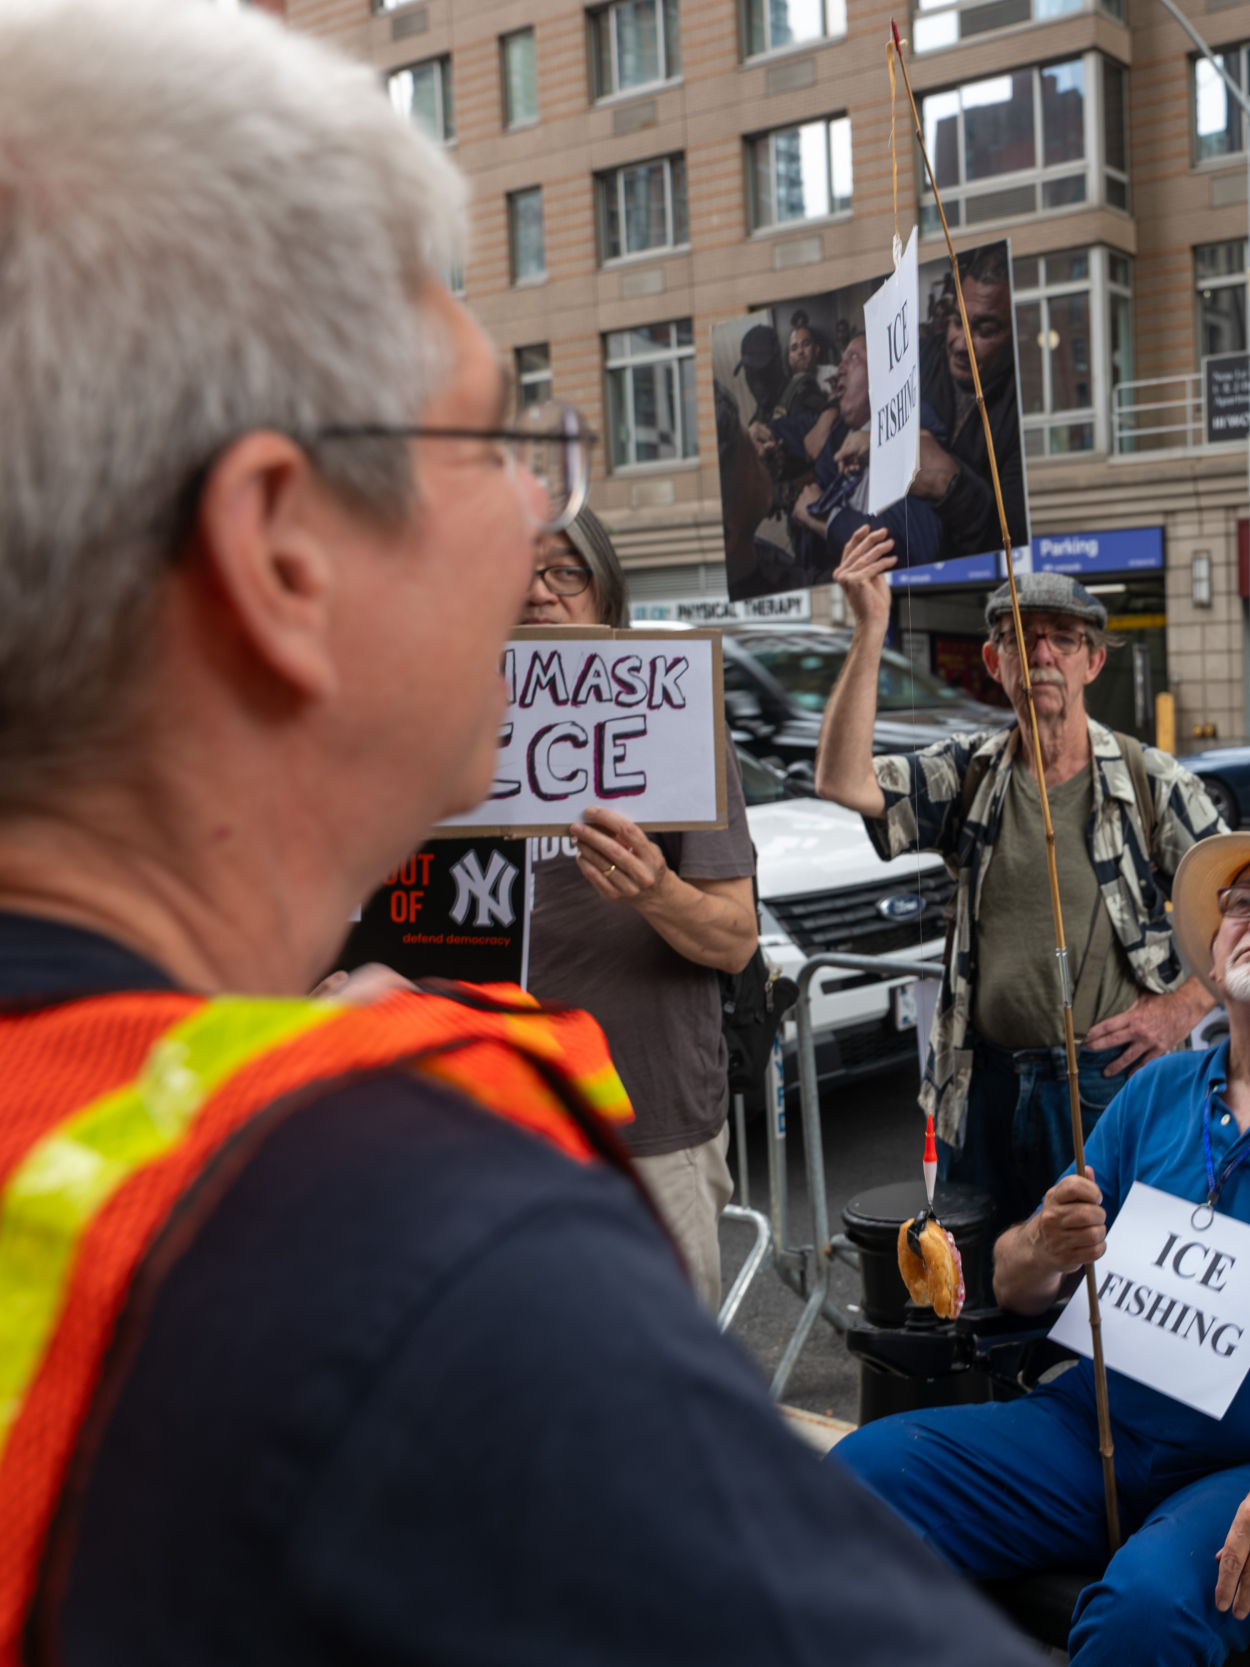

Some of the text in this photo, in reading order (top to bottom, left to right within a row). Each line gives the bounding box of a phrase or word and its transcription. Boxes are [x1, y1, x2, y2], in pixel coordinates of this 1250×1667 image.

[886, 299, 909, 372] ICE
[877, 365, 917, 447] FISHING
[1040, 536, 1099, 558] Parking
[678, 600, 738, 619] PHYSICAL
[744, 597, 803, 616] THERAPY
[390, 890, 425, 923] OF
[402, 933, 511, 947] defend democracy
[1150, 1231, 1237, 1293] ICE
[1097, 1270, 1245, 1358] FISHING
